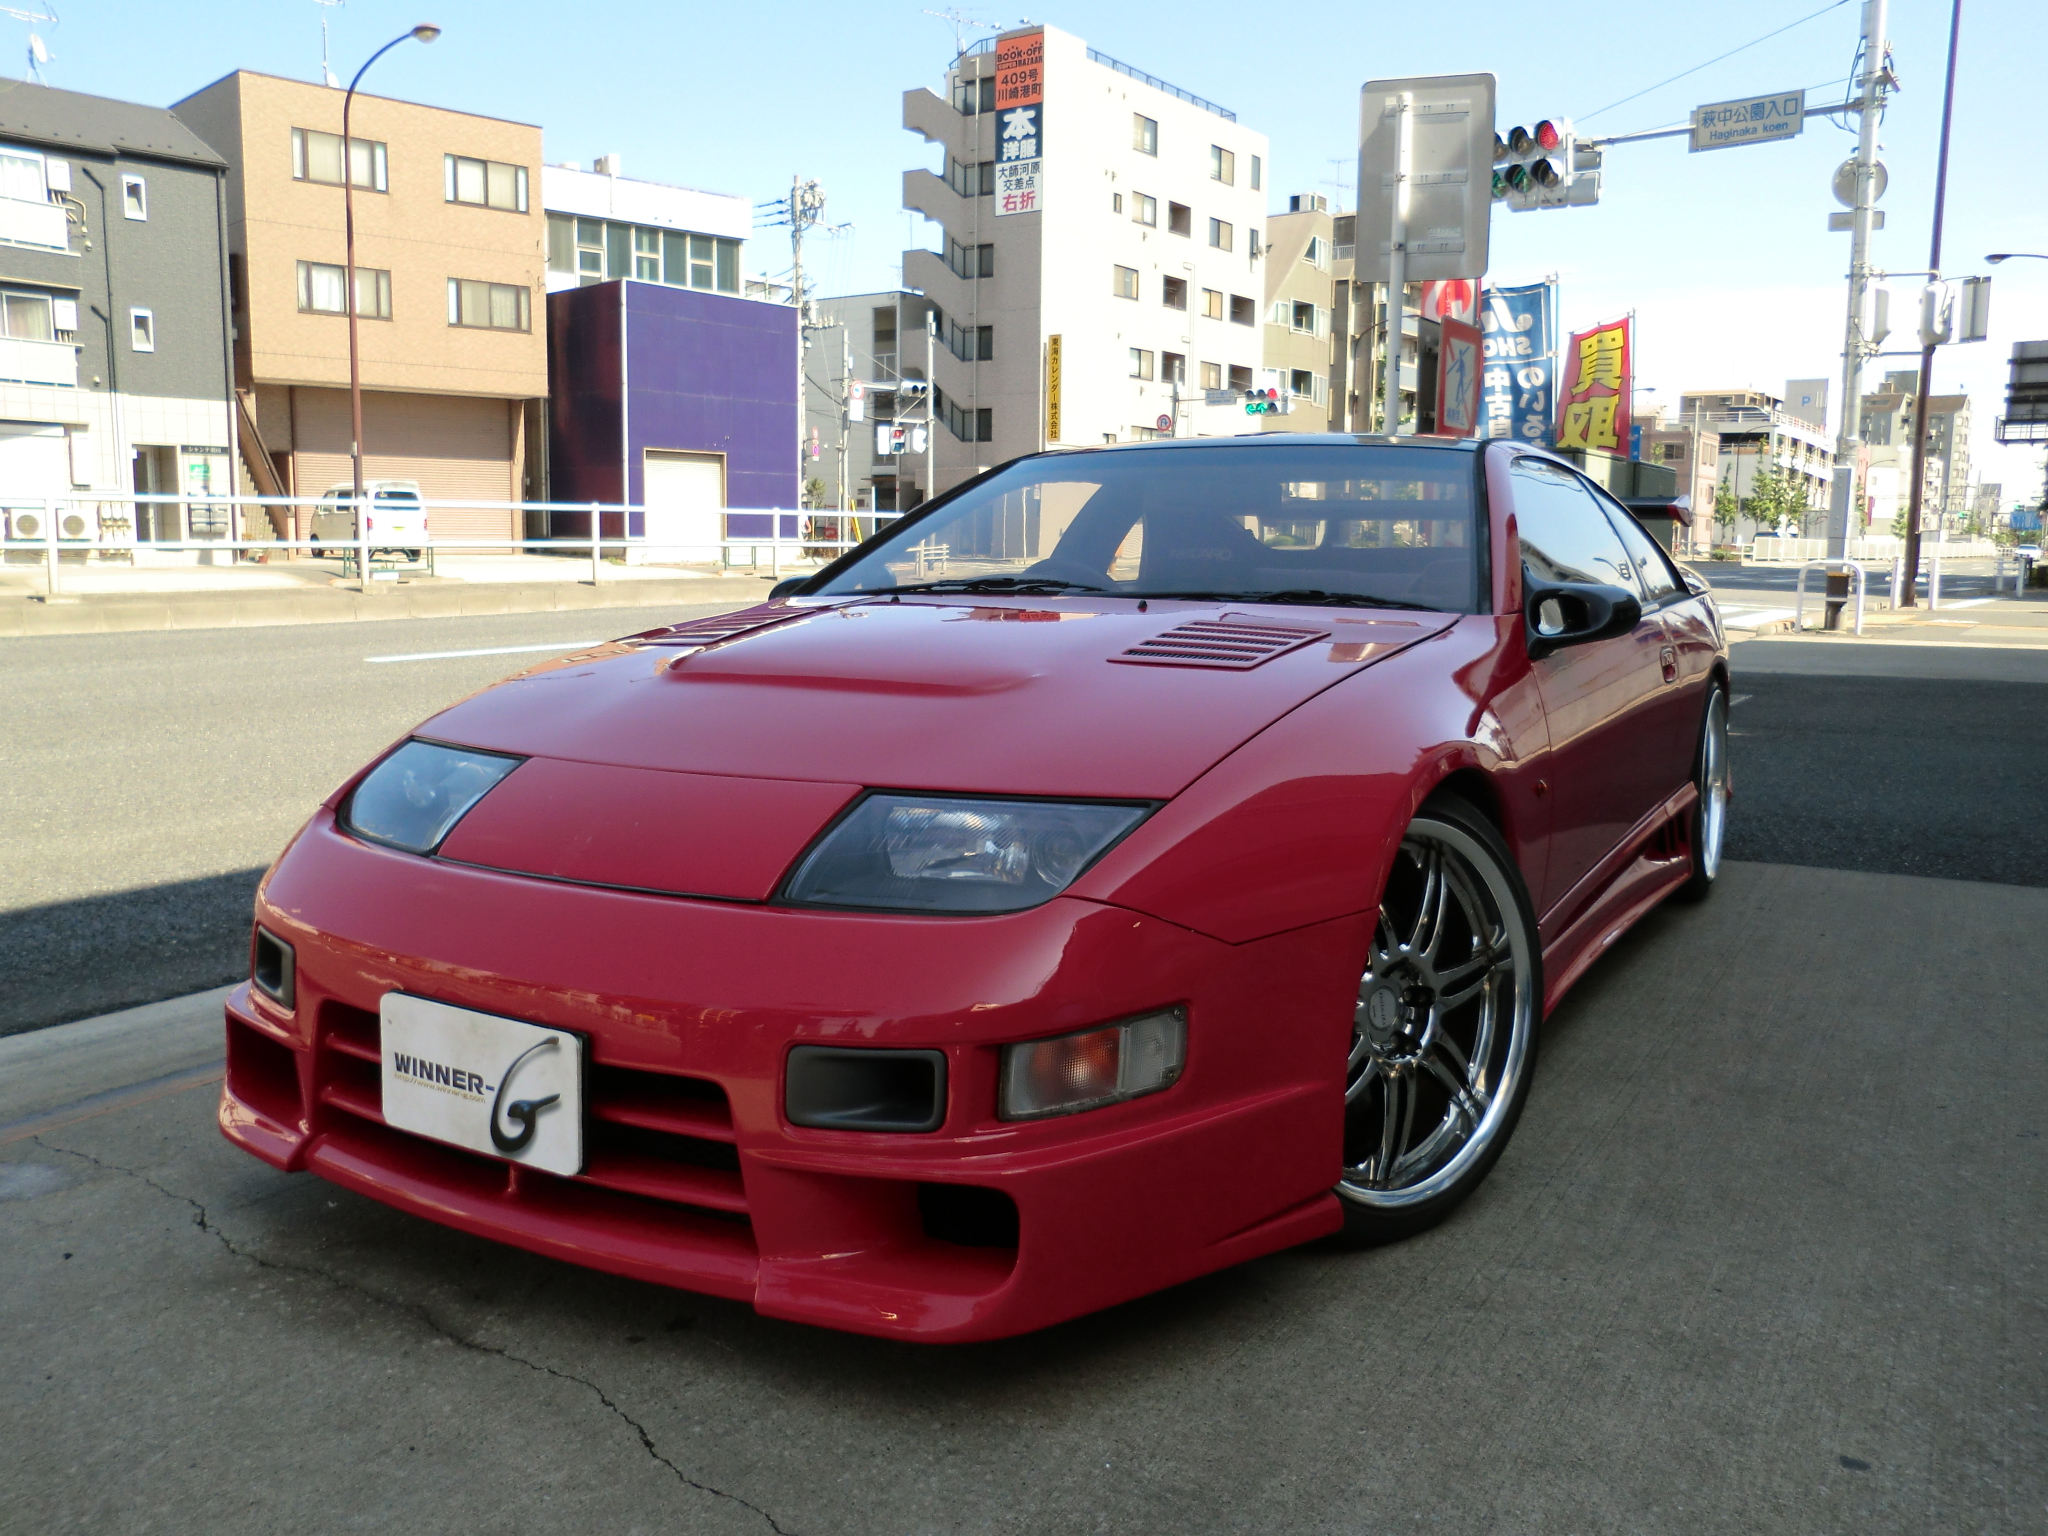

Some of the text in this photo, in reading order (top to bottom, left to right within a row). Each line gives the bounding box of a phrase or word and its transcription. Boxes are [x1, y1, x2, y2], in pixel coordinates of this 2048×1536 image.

[1018, 56, 1043, 67] BAZAAR
[1001, 68, 1039, 86] 409号
[997, 83, 1042, 102] 川崎港町
[1701, 98, 1799, 129] 萩中公園入口
[1003, 107, 1036, 140] 本
[1709, 122, 1789, 141] Haginaka koen
[1003, 138, 1036, 161] 洋服
[998, 161, 1040, 179] 大師河原
[1003, 176, 1035, 192] 交差点
[1003, 190, 1036, 212] 右折
[1050, 337, 1059, 439] 東海カレンダー株式会社
[1801, 396, 1811, 407] P
